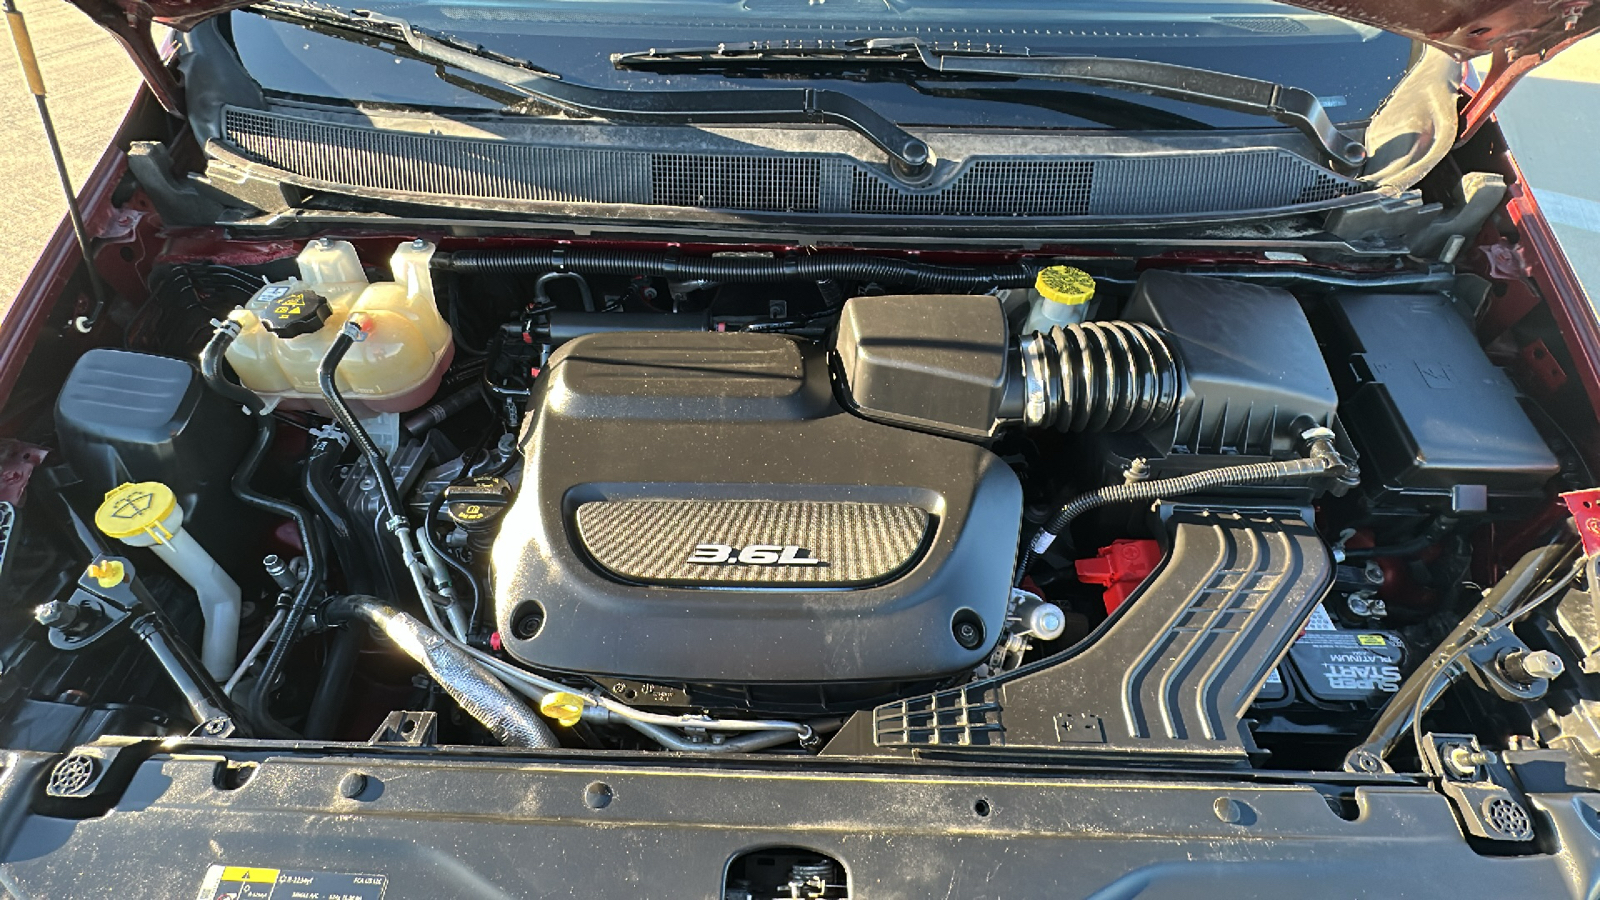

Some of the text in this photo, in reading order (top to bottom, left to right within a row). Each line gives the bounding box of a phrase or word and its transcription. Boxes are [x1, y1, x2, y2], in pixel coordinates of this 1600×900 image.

[687, 544, 819, 564] 3.6L
[1330, 655, 1392, 663] PLATINUM
[1325, 666, 1402, 680] START
[1329, 677, 1400, 692] SUPER
